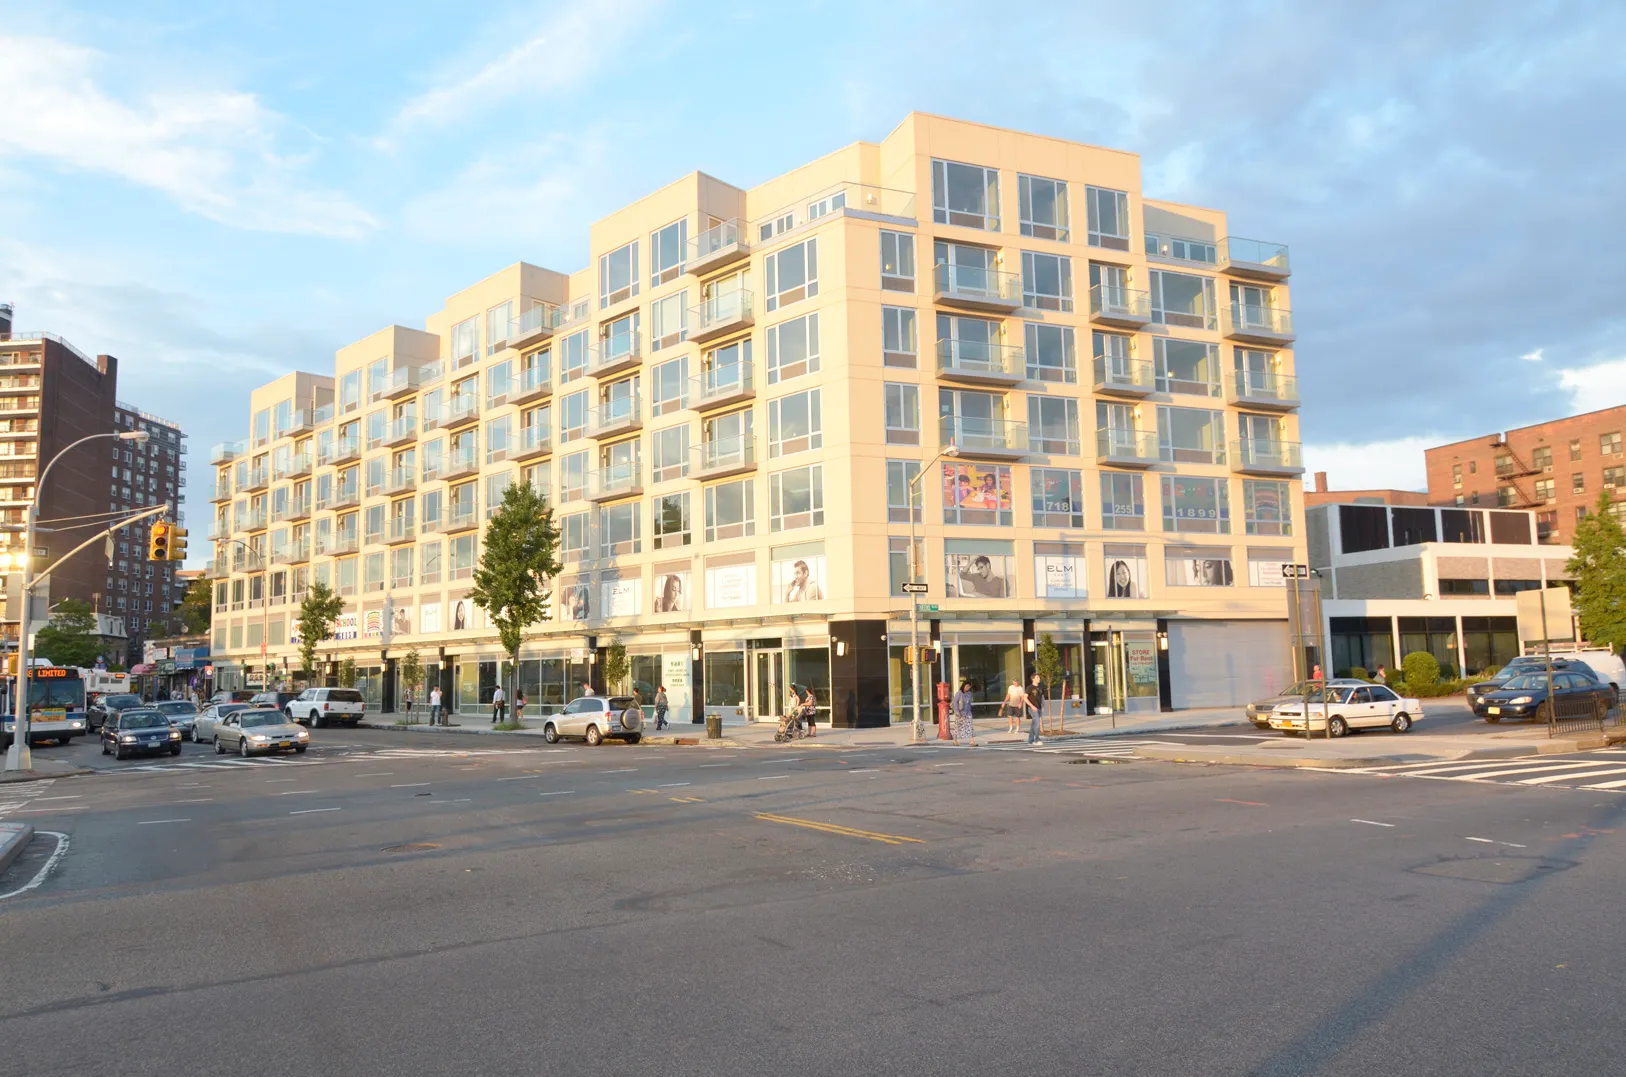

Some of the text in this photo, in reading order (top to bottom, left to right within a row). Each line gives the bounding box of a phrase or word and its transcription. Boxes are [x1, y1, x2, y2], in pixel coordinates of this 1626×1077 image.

[1046, 501, 1217, 518] 718 255 1899
[612, 587, 630, 595] ELM
[335, 617, 357, 628] SCHOOL
[38, 669, 66, 678] LIMITED
